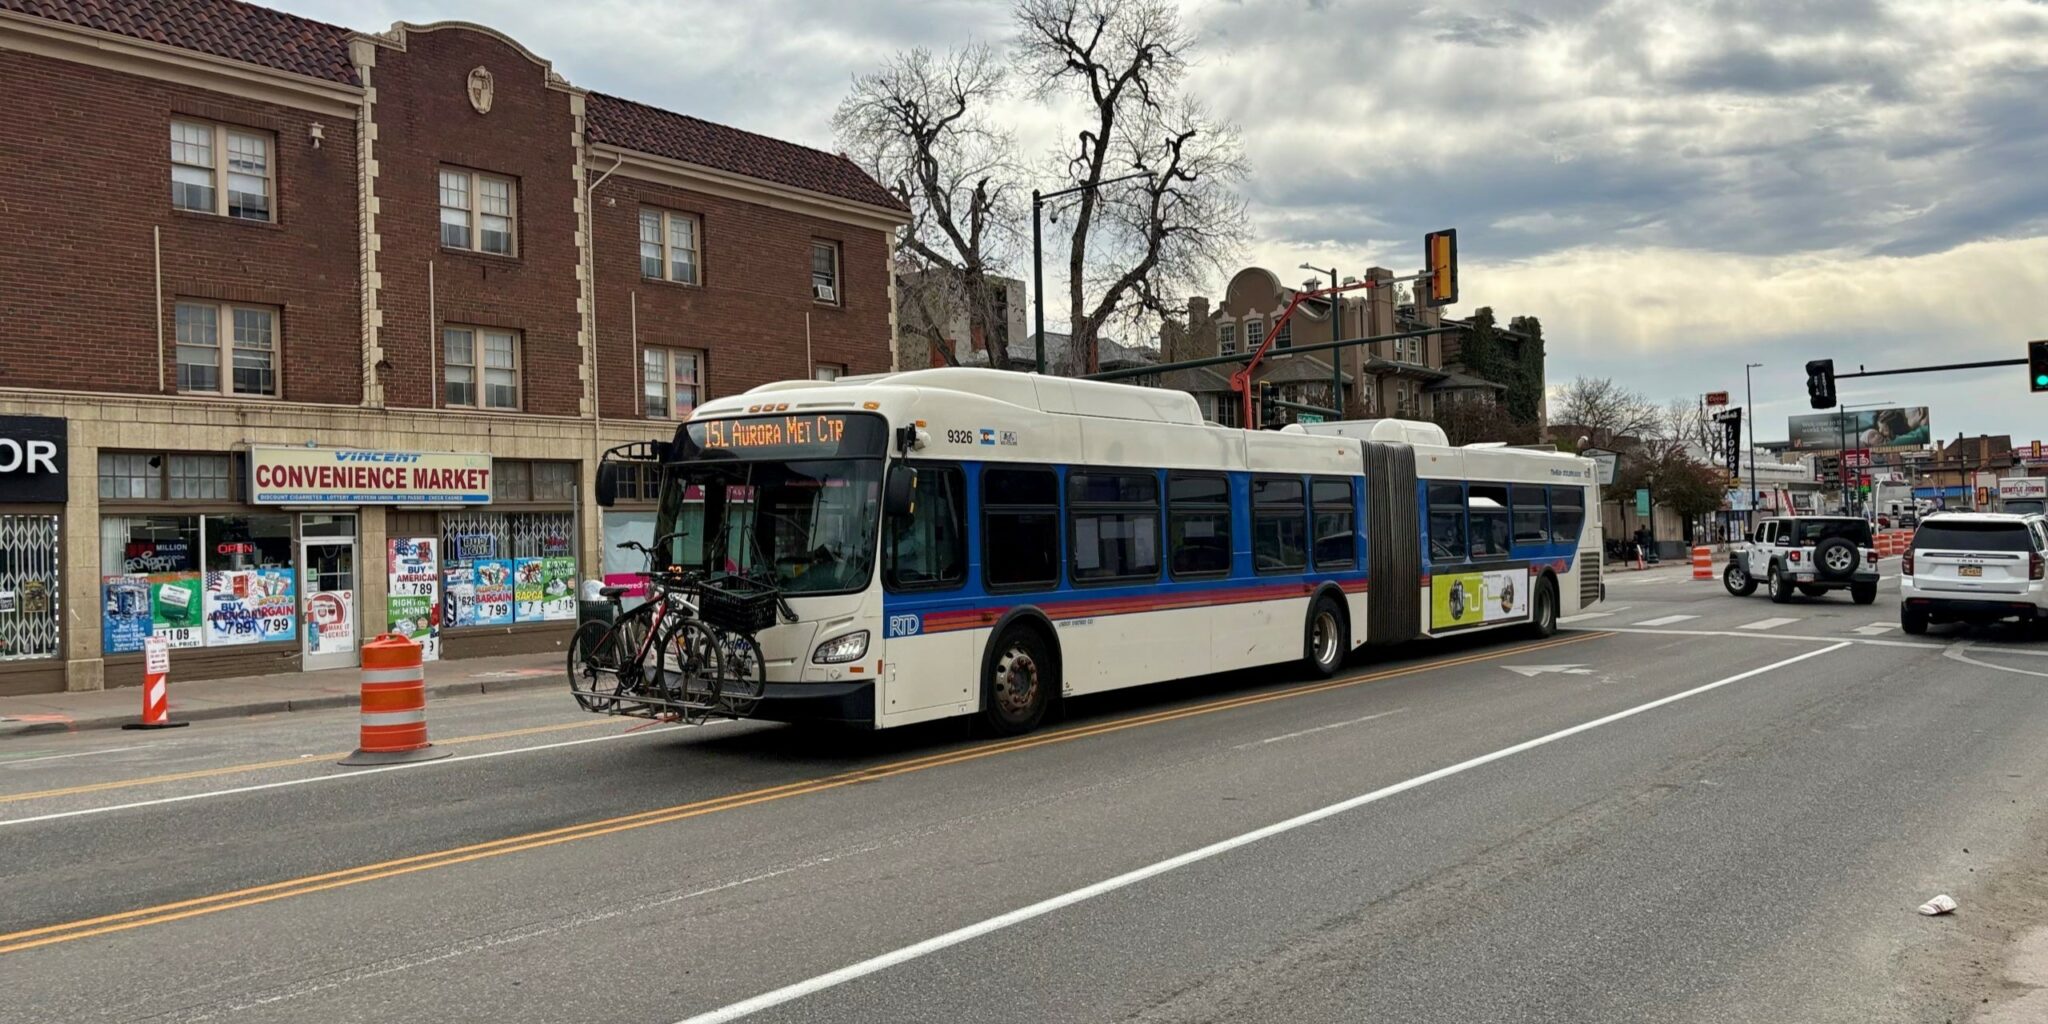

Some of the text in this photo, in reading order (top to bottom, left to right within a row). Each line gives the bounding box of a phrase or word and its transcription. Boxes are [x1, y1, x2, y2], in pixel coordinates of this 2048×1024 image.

[704, 421, 729, 448] 15L
[947, 429, 973, 444] 9326
[0, 437, 60, 474] OR
[335, 451, 422, 463] VINCENT
[256, 464, 490, 490] CONVENIENCE MARKET
[156, 543, 188, 551] MILLION
[217, 543, 253, 554] OPEN
[407, 566, 426, 574] BUY
[397, 574, 438, 582] AMERICAN
[412, 583, 433, 595] 789
[476, 593, 512, 603] BARGAIN
[515, 591, 543, 601] BARGA
[221, 602, 244, 611] BUY
[488, 604, 508, 615] 799
[263, 618, 289, 632] 799
[889, 614, 920, 637] RTD
